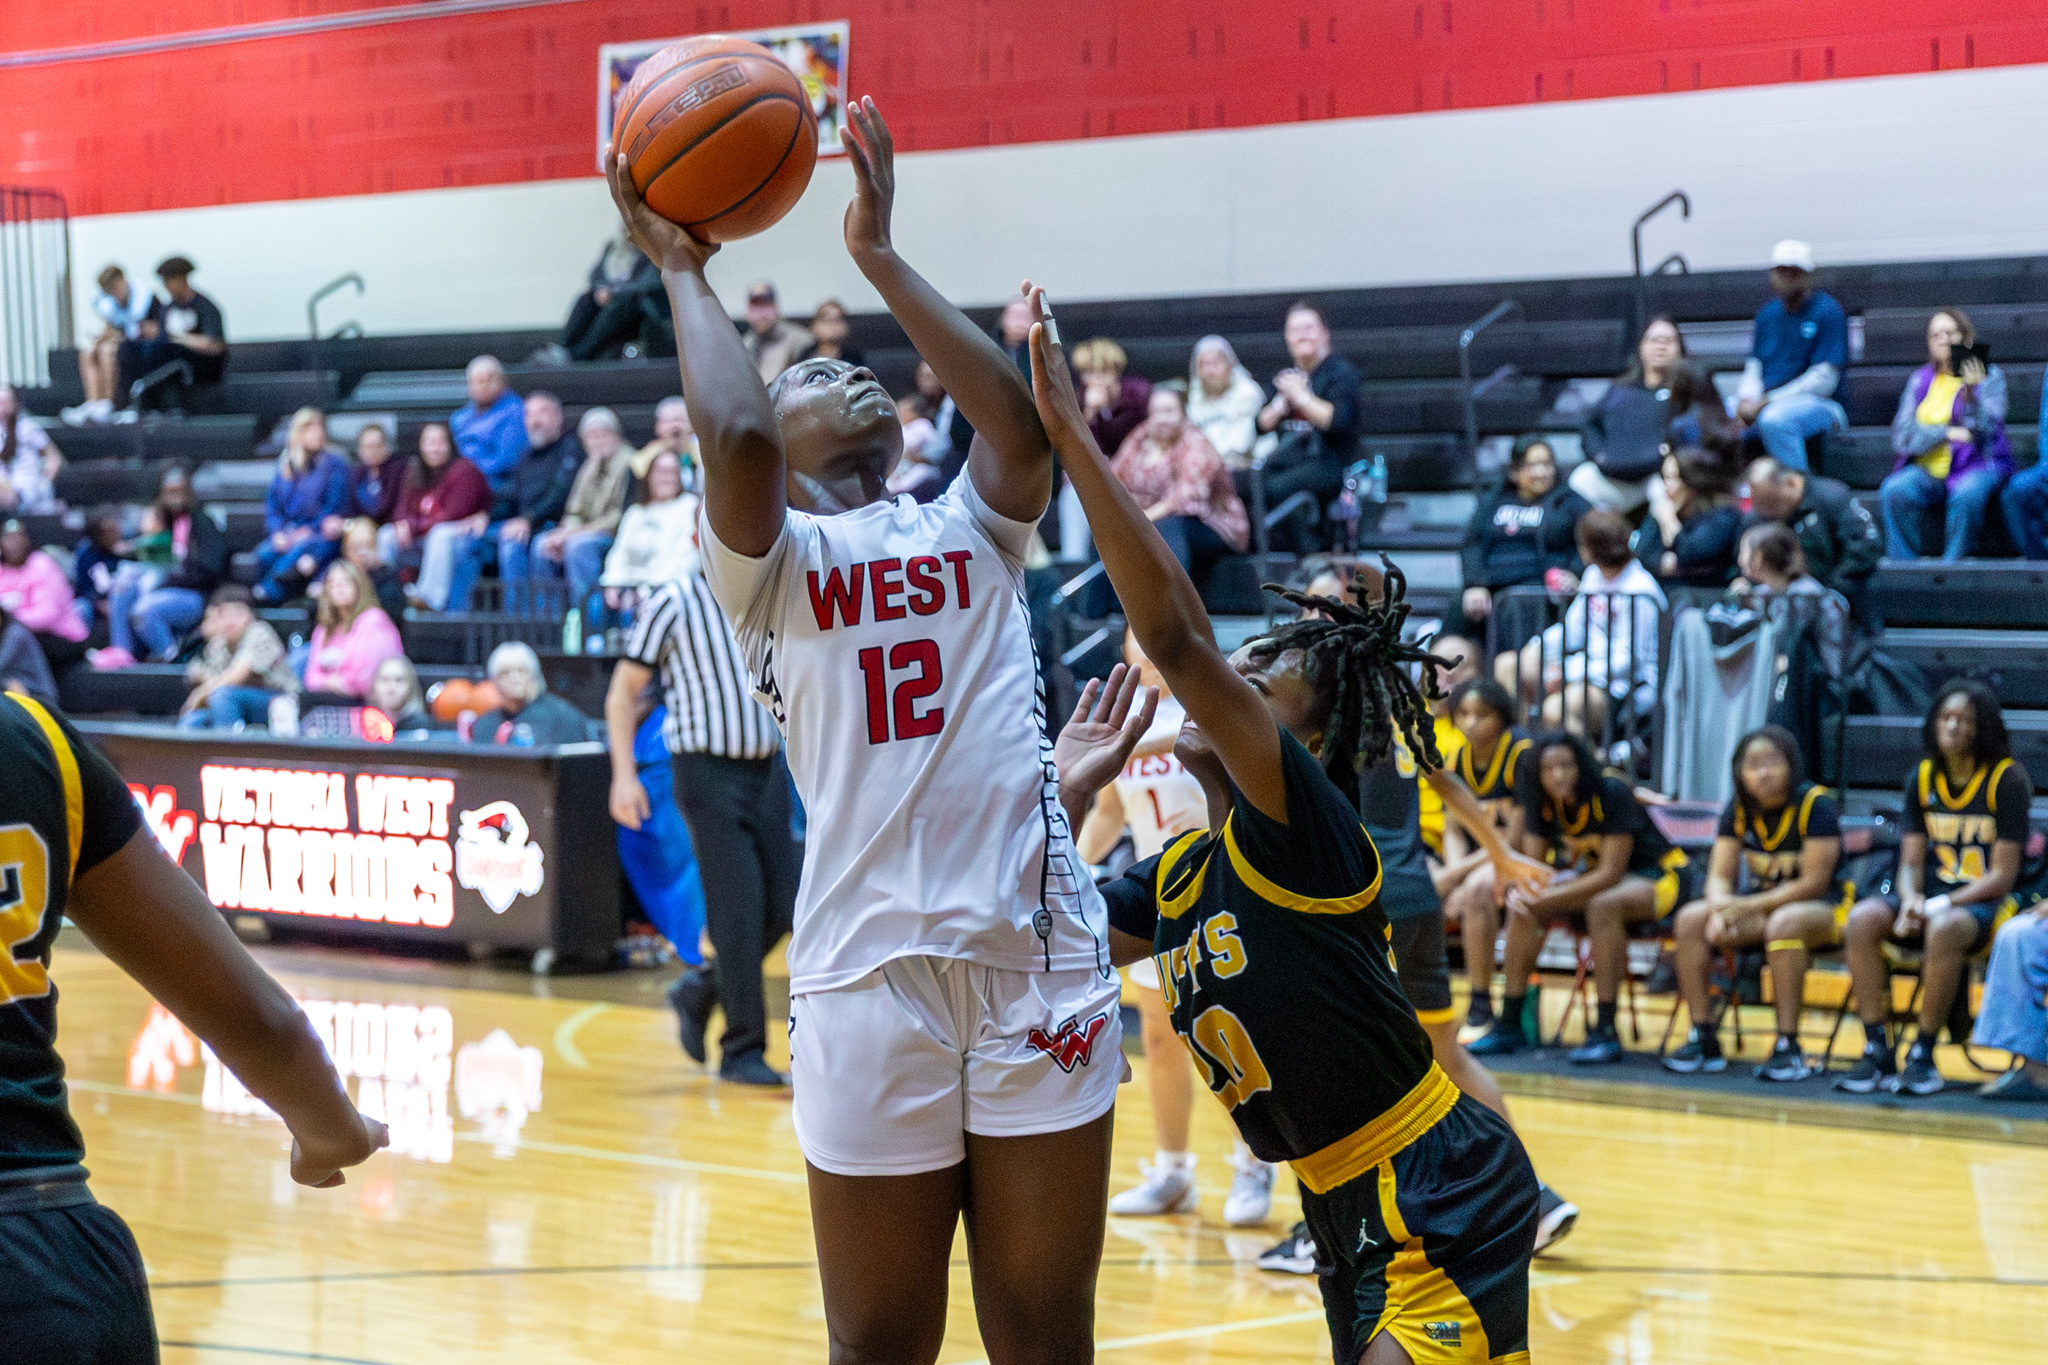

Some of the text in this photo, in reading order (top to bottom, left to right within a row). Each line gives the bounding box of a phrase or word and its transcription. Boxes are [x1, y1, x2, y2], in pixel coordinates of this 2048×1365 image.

[806, 550, 974, 632] WEST
[858, 638, 945, 746] 12
[201, 765, 348, 831] VICTORIA
[355, 774, 455, 839] WEST
[1146, 786, 1163, 830] 1
[199, 822, 455, 929] WARRIORS
